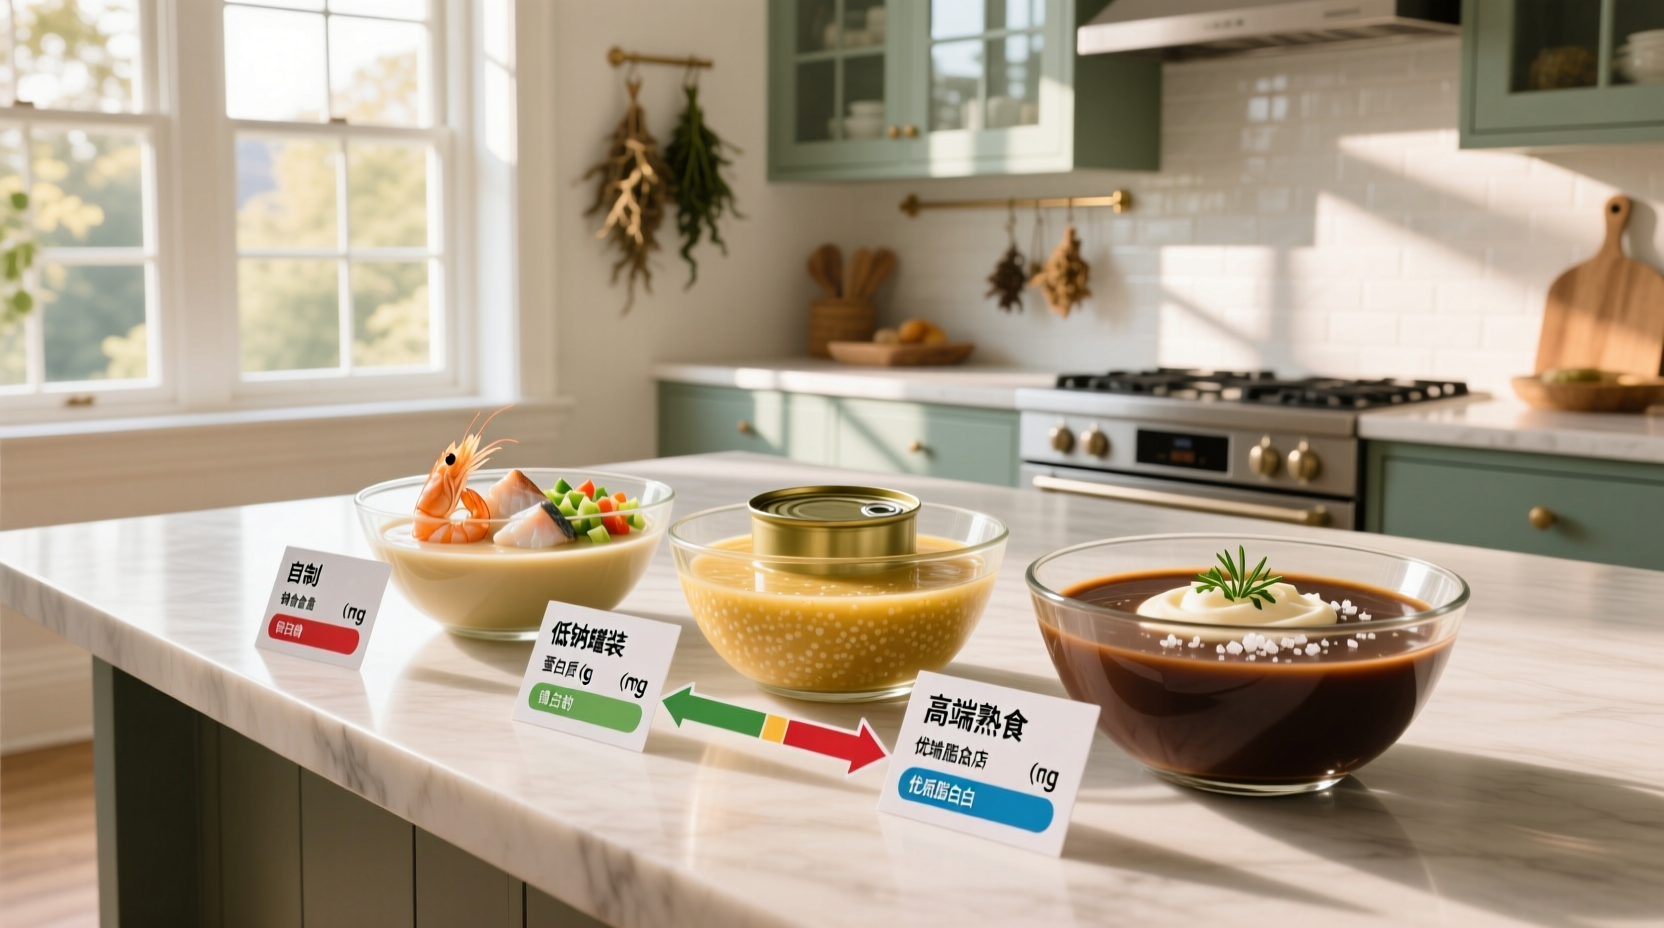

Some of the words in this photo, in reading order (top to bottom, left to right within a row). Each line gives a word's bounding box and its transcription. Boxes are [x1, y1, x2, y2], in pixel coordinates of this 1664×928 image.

[287, 561, 323, 587] 自制
[924, 693, 1028, 742] 高端熟食
